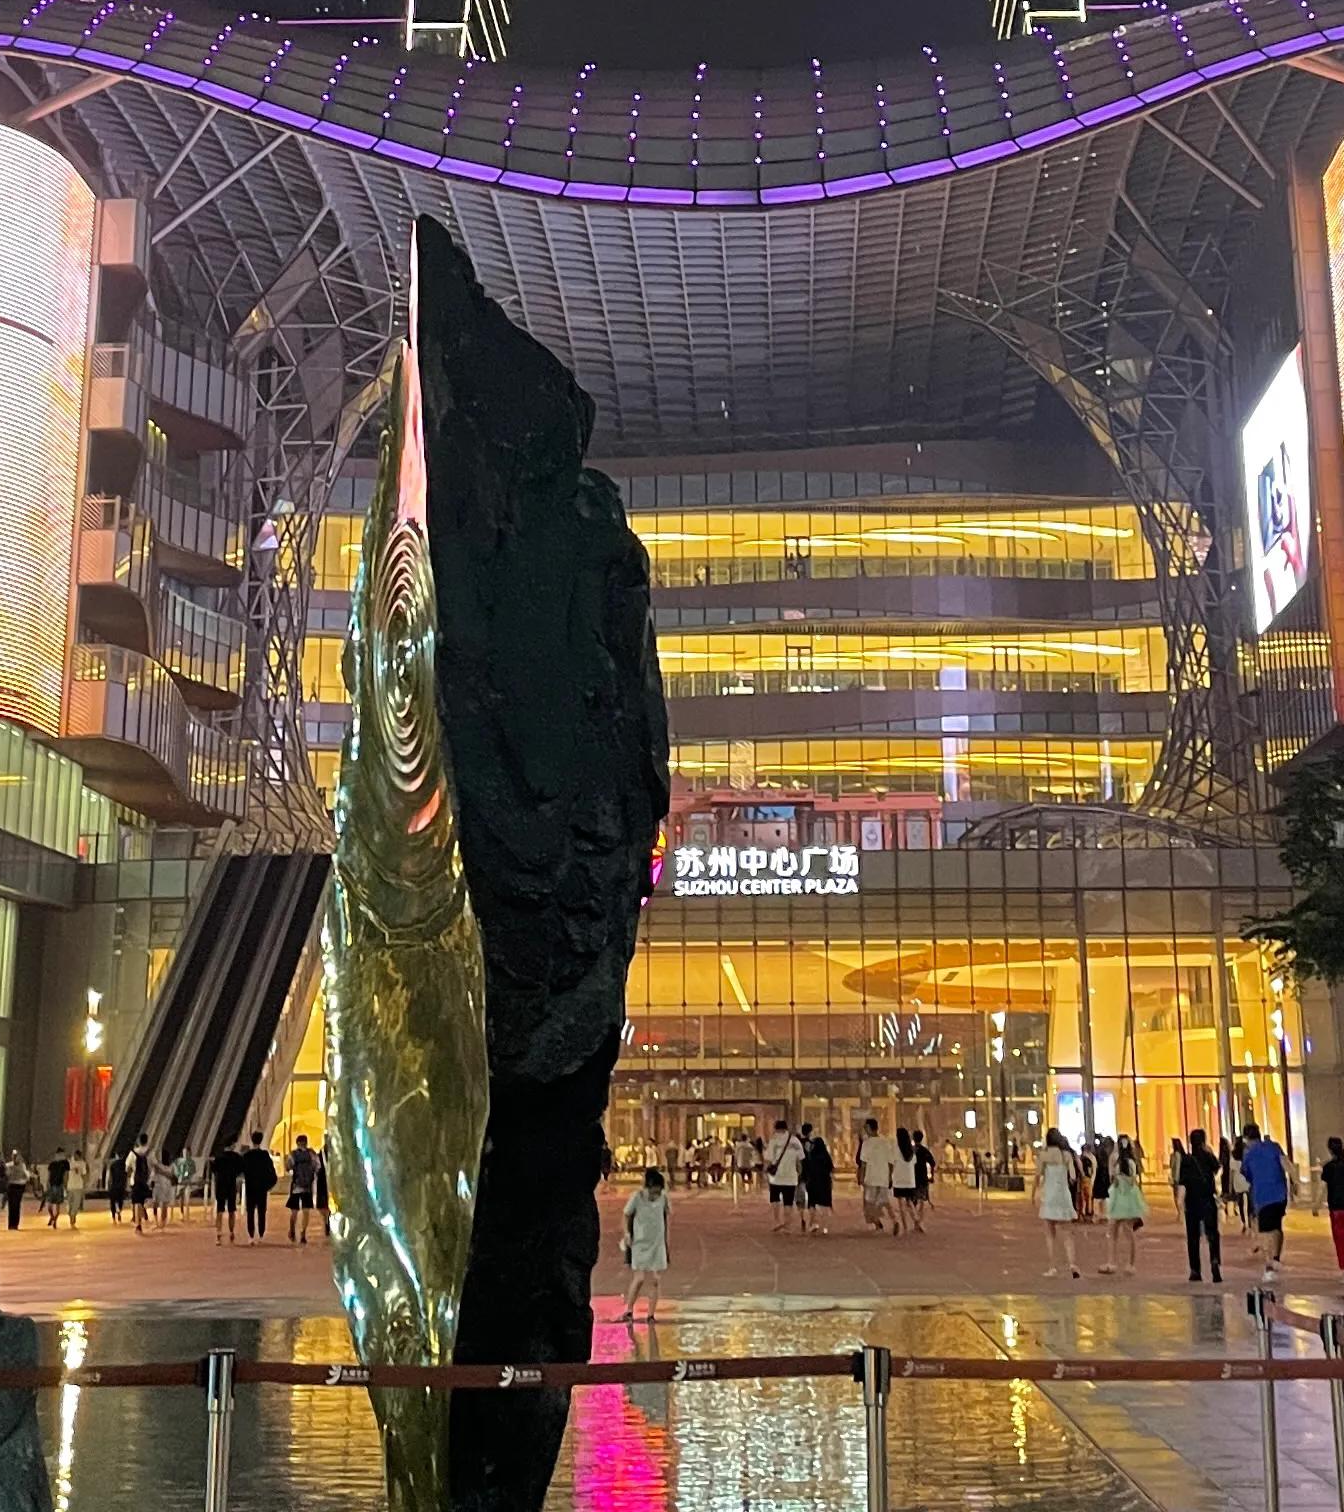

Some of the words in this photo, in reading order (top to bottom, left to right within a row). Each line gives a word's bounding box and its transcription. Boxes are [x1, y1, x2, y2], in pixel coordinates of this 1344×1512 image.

[674, 845, 860, 877] 苏州中心广场
[674, 878, 738, 896] SUZHOU
[740, 878, 803, 895] CENTER
[805, 878, 859, 895] PLAZA
